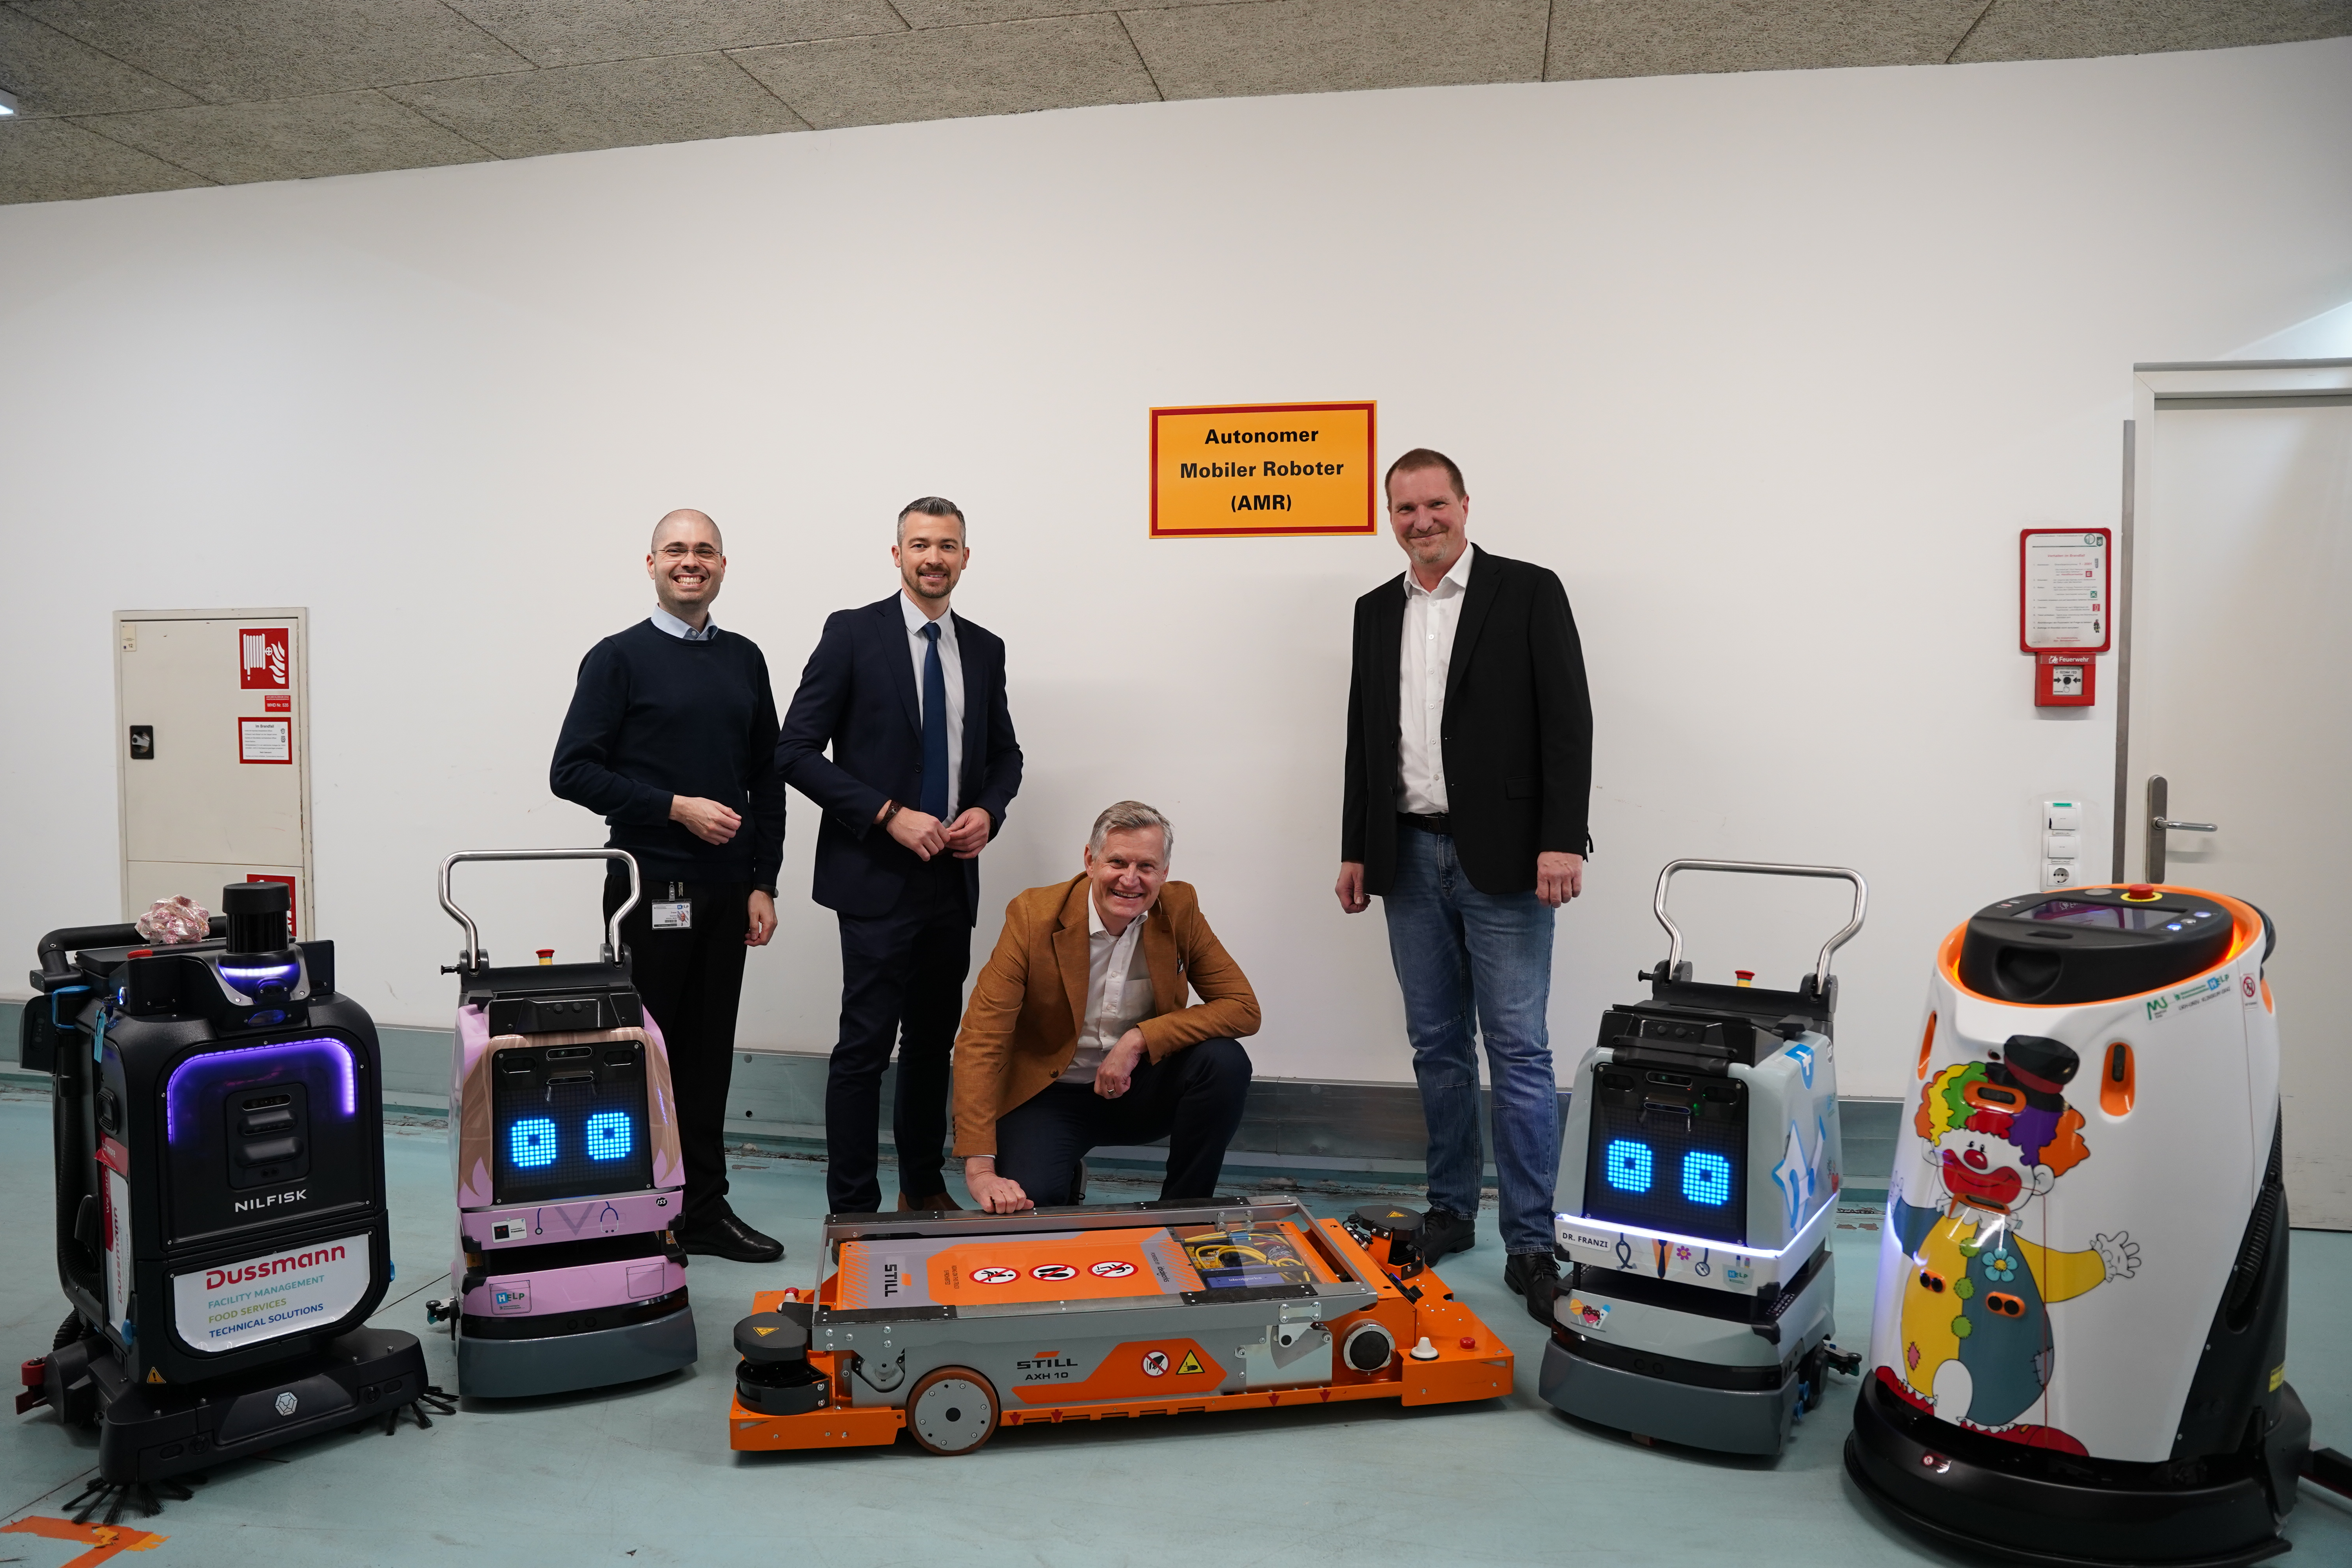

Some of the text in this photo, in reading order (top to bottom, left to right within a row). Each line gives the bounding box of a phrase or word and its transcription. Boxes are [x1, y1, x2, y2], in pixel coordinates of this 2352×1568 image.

[1205, 429, 1319, 445] Autonomer
[1180, 461, 1344, 478] Mobiler Roboter
[1231, 494, 1292, 513] (AMR)
[107, 1145, 116, 1158] more
[235, 1189, 307, 1212] NILFISK
[1563, 1232, 1608, 1248] DR. FRANZI
[114, 1207, 122, 1304] Dussmann
[206, 1245, 345, 1290] Dussmann
[1157, 1266, 1170, 1282] idealworks
[884, 1264, 898, 1297] STILL
[208, 1275, 325, 1309] FACILITY MANAGEMENT
[498, 1292, 525, 1303] HELP
[209, 1298, 287, 1323] FOOD SERVICES
[209, 1303, 324, 1338] TECHNICAL SOLUTIONS
[1017, 1358, 1078, 1369] STILL
